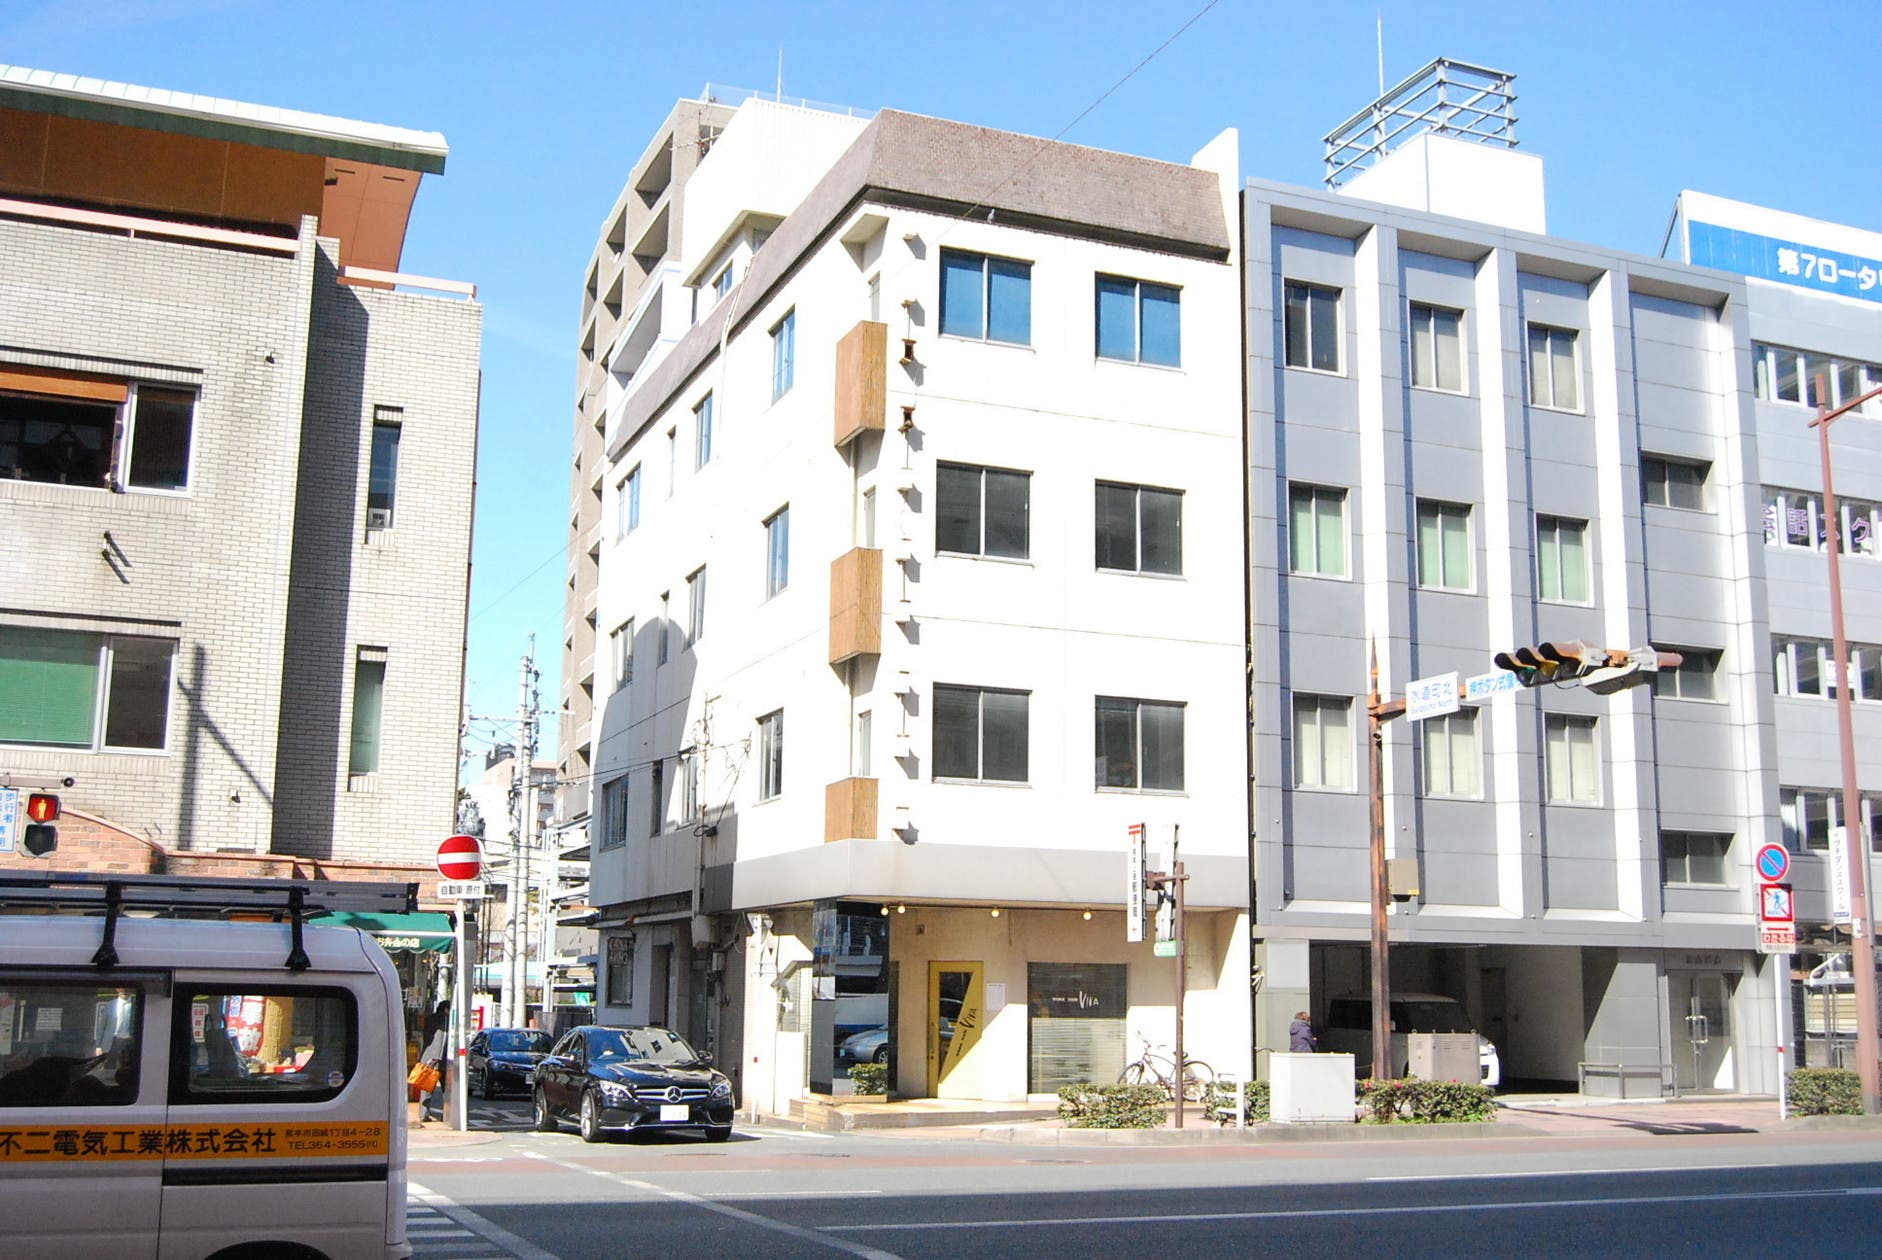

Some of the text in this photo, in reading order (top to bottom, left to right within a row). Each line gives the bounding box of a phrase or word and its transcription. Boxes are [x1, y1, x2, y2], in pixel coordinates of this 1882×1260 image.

[1777, 247, 1882, 290] 第7ロータ
[0, 1128, 277, 1156] 不二電気工業株式会社
